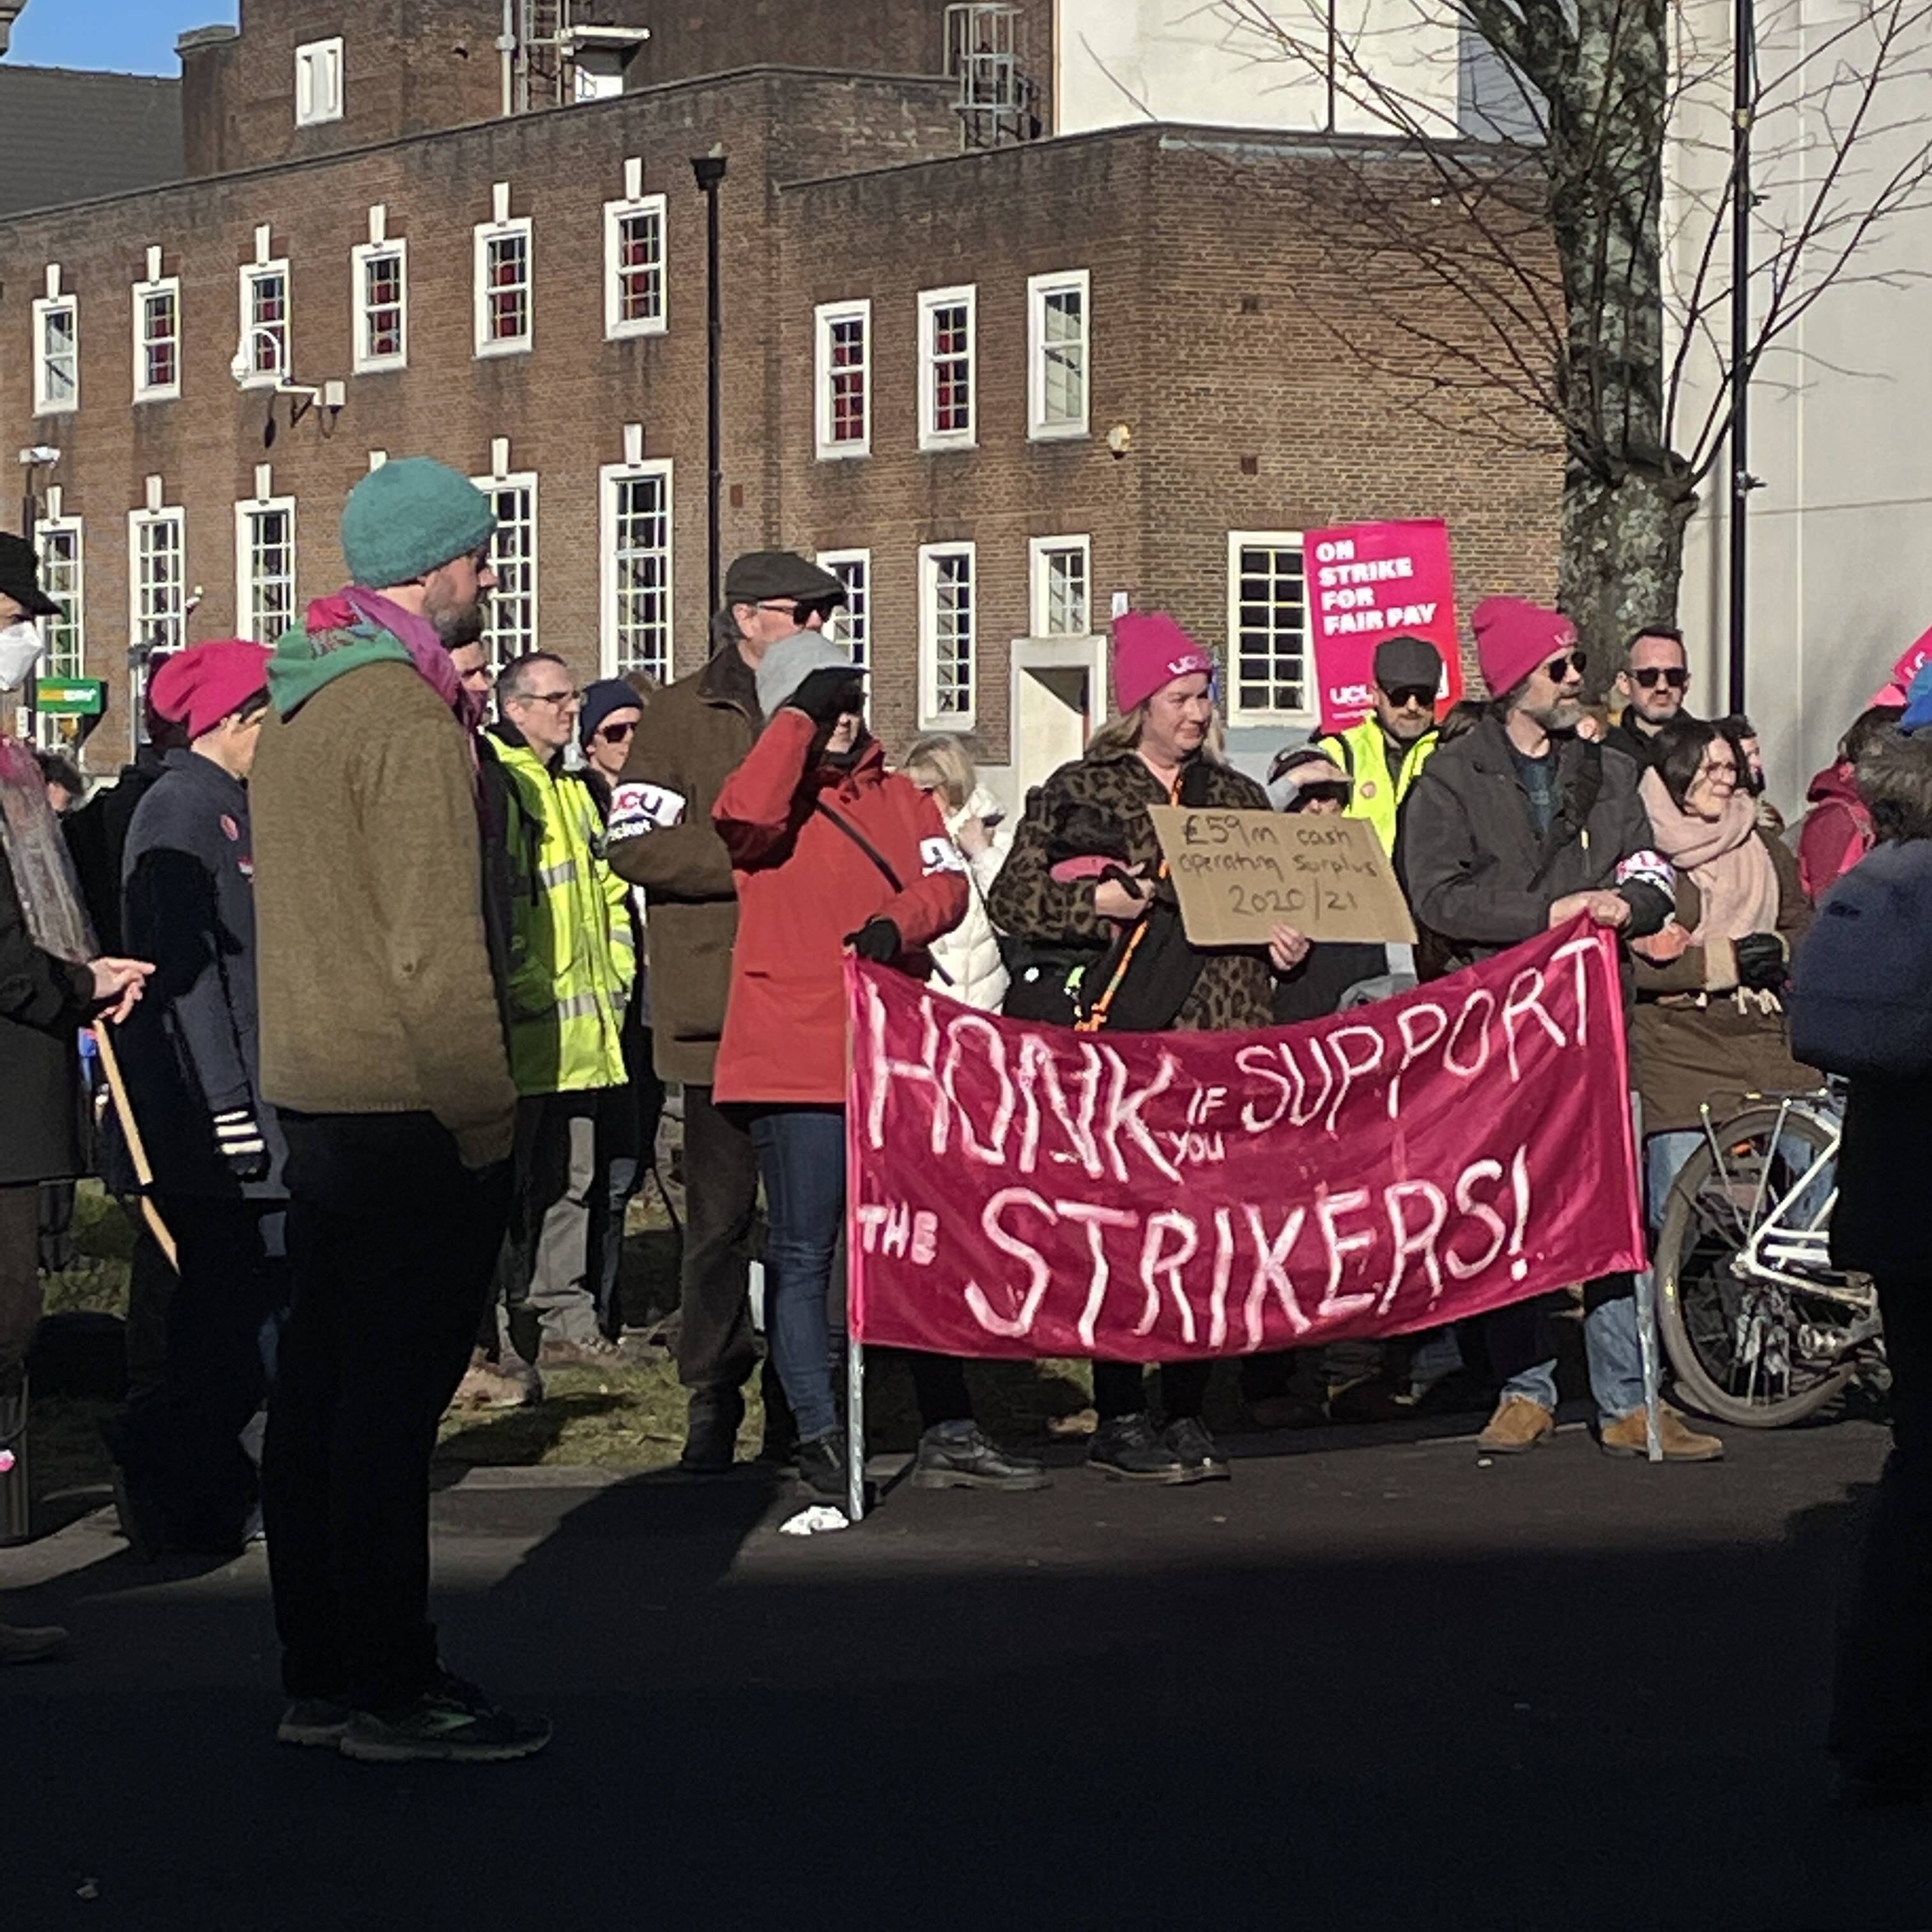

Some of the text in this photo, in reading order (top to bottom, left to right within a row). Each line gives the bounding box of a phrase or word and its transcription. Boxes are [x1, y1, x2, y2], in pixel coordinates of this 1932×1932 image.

[1315, 539, 1354, 562] ON
[1318, 556, 1414, 586] STRIKE
[1321, 586, 1376, 611] FOR
[1323, 603, 1438, 636] FAIR PAY
[1181, 815, 1354, 847] £59m cash
[1177, 852, 1285, 883] operating
[1228, 878, 1359, 921] 2020/21
[867, 982, 1184, 1185] HONK
[1186, 1086, 1227, 1124] IF
[1234, 937, 1602, 1140] SUPPORT
[859, 1144, 1530, 1351] THE STRIKERS!
